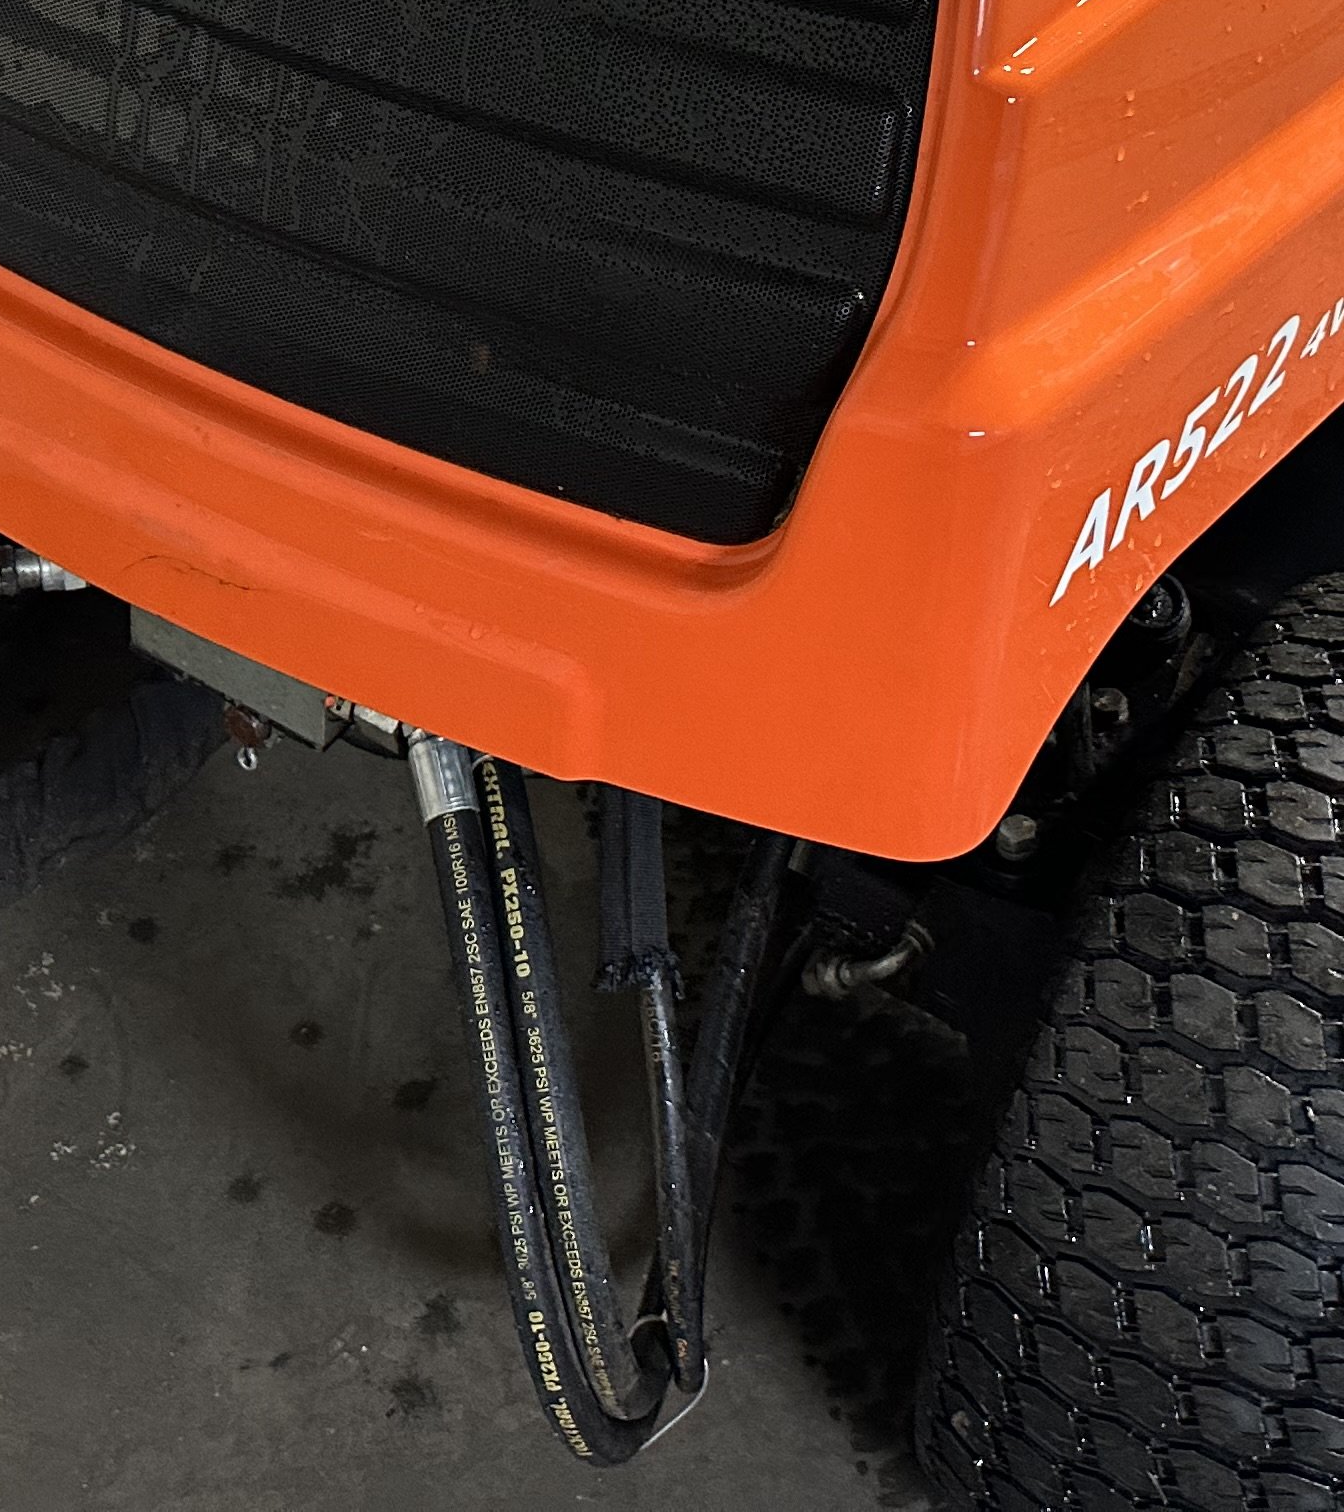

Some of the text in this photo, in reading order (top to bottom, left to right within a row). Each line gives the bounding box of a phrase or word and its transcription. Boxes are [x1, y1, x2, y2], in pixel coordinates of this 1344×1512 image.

[1048, 314, 1301, 608] AR522
[448, 842, 469, 895] 100R16
[457, 897, 475, 930] SAE
[499, 866, 532, 979] PX250-10
[464, 931, 482, 964] 2SC
[469, 967, 490, 1016] EN857
[478, 1017, 501, 1094] EXCEEDS
[527, 1026, 545, 1064] 3625
[532, 1066, 550, 1093] PSI
[490, 1097, 506, 1122] OR
[539, 1095, 555, 1124] WP
[495, 1125, 516, 1180] MEETS
[543, 1125, 565, 1181] MEETS
[503, 1182, 522, 1208] WP
[553, 1183, 570, 1208] OR
[509, 1210, 525, 1235] PSI
[557, 1210, 584, 1280] EXCEEDS
